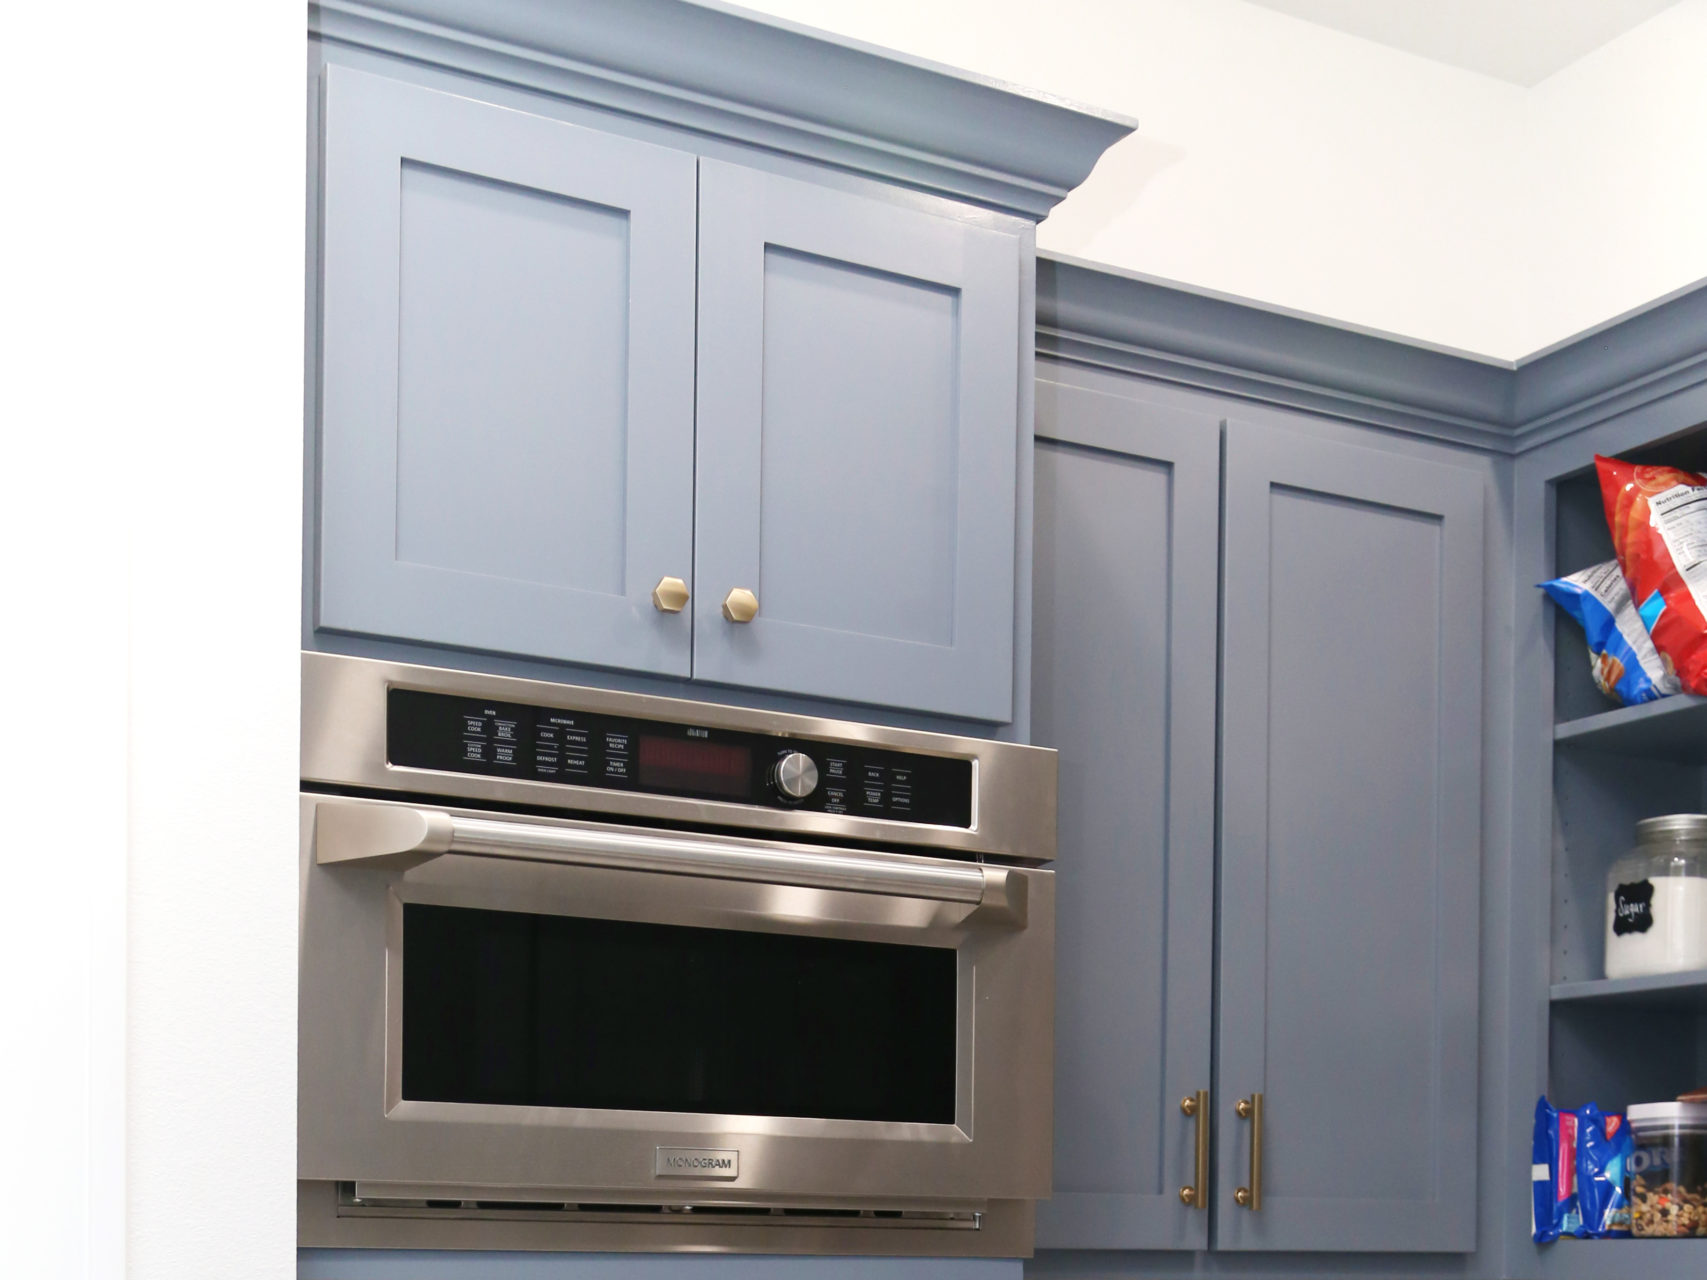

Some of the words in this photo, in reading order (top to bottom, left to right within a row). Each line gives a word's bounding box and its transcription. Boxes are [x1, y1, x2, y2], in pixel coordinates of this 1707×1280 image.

[1656, 490, 1690, 506] Nutrition
[540, 731, 555, 739] COOK
[567, 735, 587, 743] EXPRESS
[606, 736, 628, 745] FAVORITE
[536, 755, 558, 763] DEFROST
[567, 758, 585, 766] REHEAT
[891, 796, 910, 804] OPTIONS
[1618, 895, 1646, 923] Sugar
[666, 1157, 732, 1169] MONOGRAM
